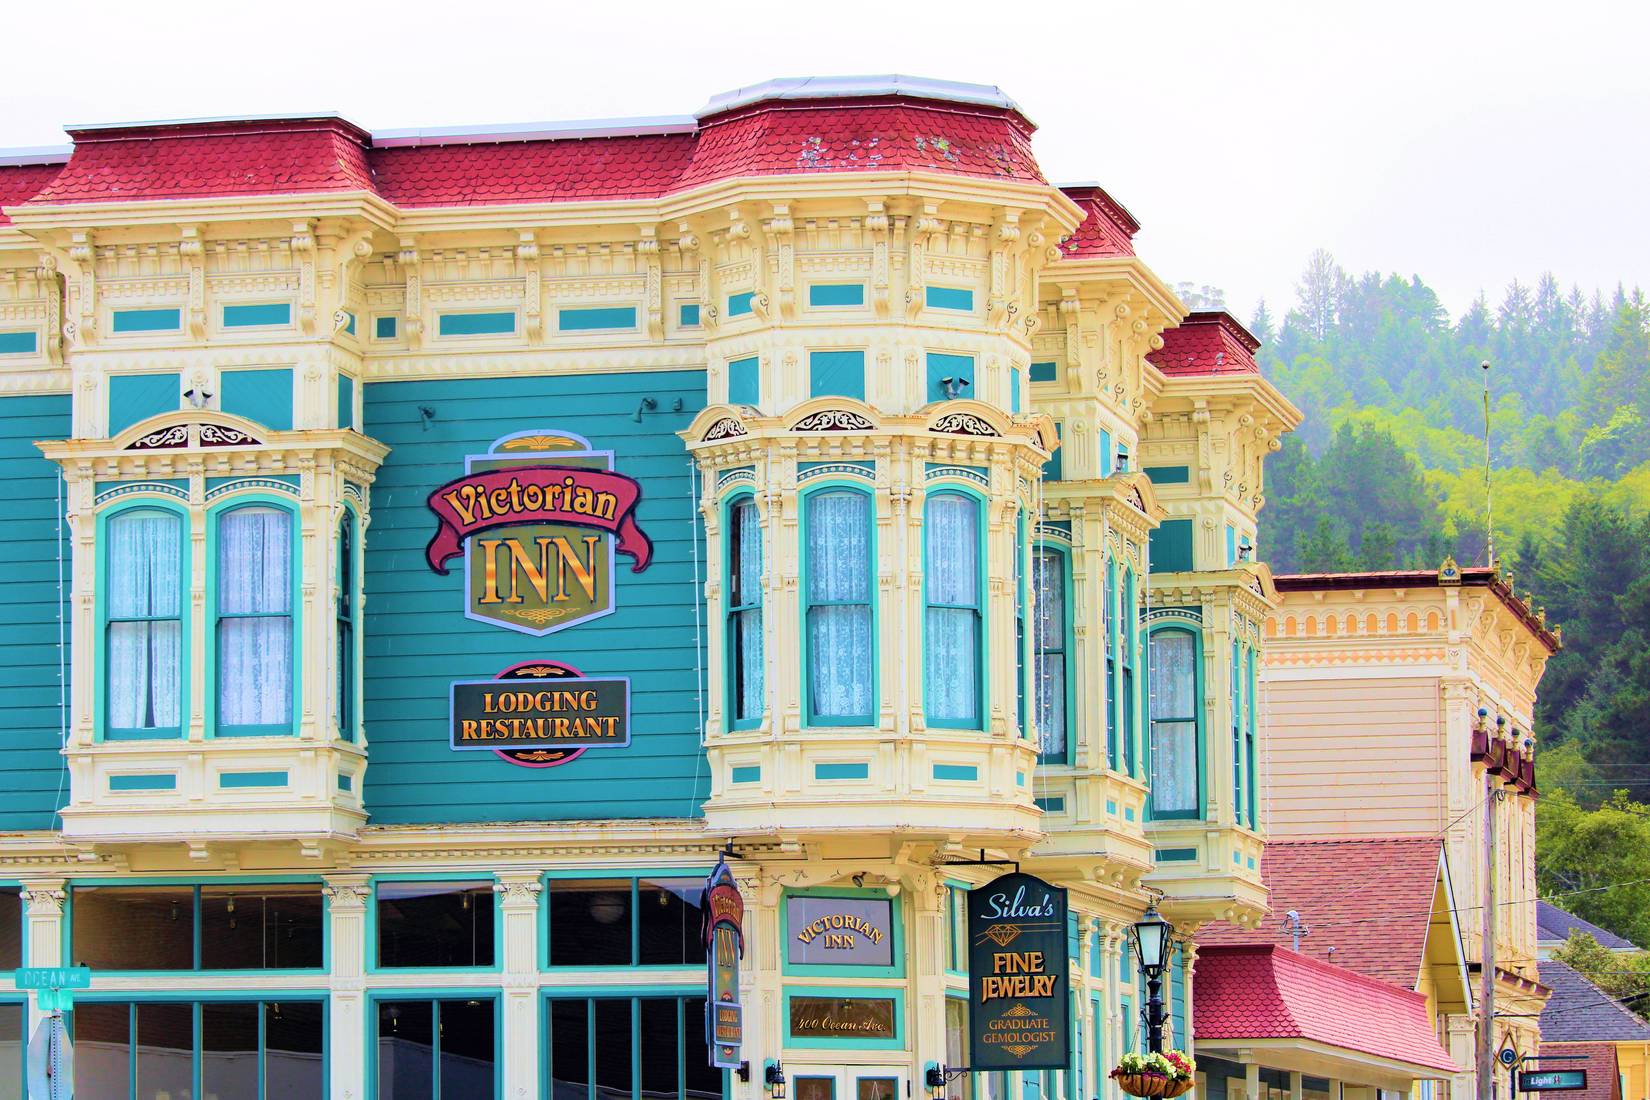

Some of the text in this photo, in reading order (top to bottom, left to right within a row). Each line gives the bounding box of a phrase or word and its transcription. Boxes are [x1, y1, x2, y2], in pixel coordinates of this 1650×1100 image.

[443, 476, 618, 526] Victorian
[479, 537, 599, 603] INN
[484, 691, 597, 713] LODGING
[461, 717, 619, 740] RESTAURANT
[980, 885, 1054, 919] Silva's
[797, 914, 884, 945] VICTORIAN
[824, 934, 855, 949] INN
[993, 951, 1044, 974] FINE
[24, 971, 65, 986] OCEAN
[982, 975, 1057, 1004] JEWELRY
[822, 1015, 856, 1031] Ocean
[989, 1018, 1049, 1030] GRADUATE
[983, 1031, 1056, 1044] GEMOLOGIST
[1502, 1050, 1513, 1063] G
